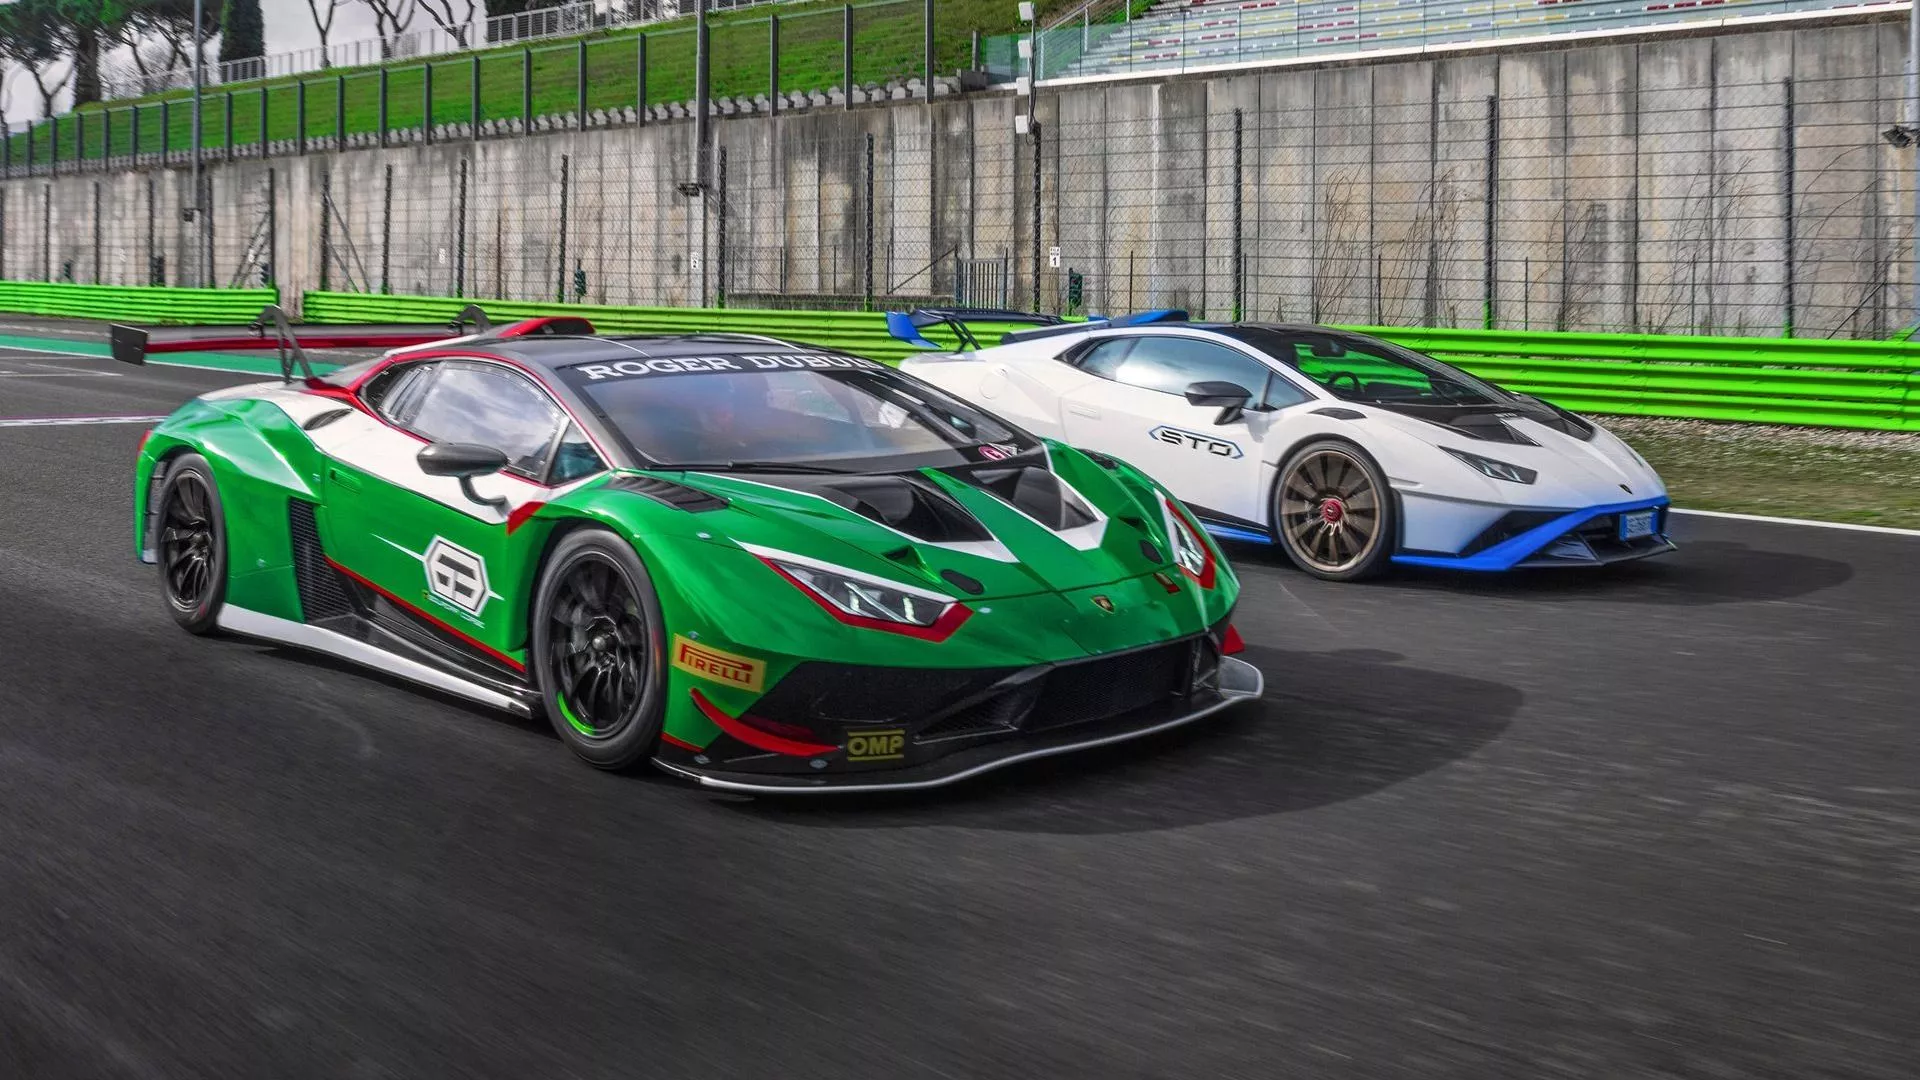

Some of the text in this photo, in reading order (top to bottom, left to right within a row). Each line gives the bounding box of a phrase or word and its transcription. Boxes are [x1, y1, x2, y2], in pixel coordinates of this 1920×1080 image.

[576, 354, 885, 379] ROGER DUBUIS
[1160, 429, 1232, 457] STO
[680, 643, 753, 684] PIRELLI
[847, 735, 905, 756] OMP
